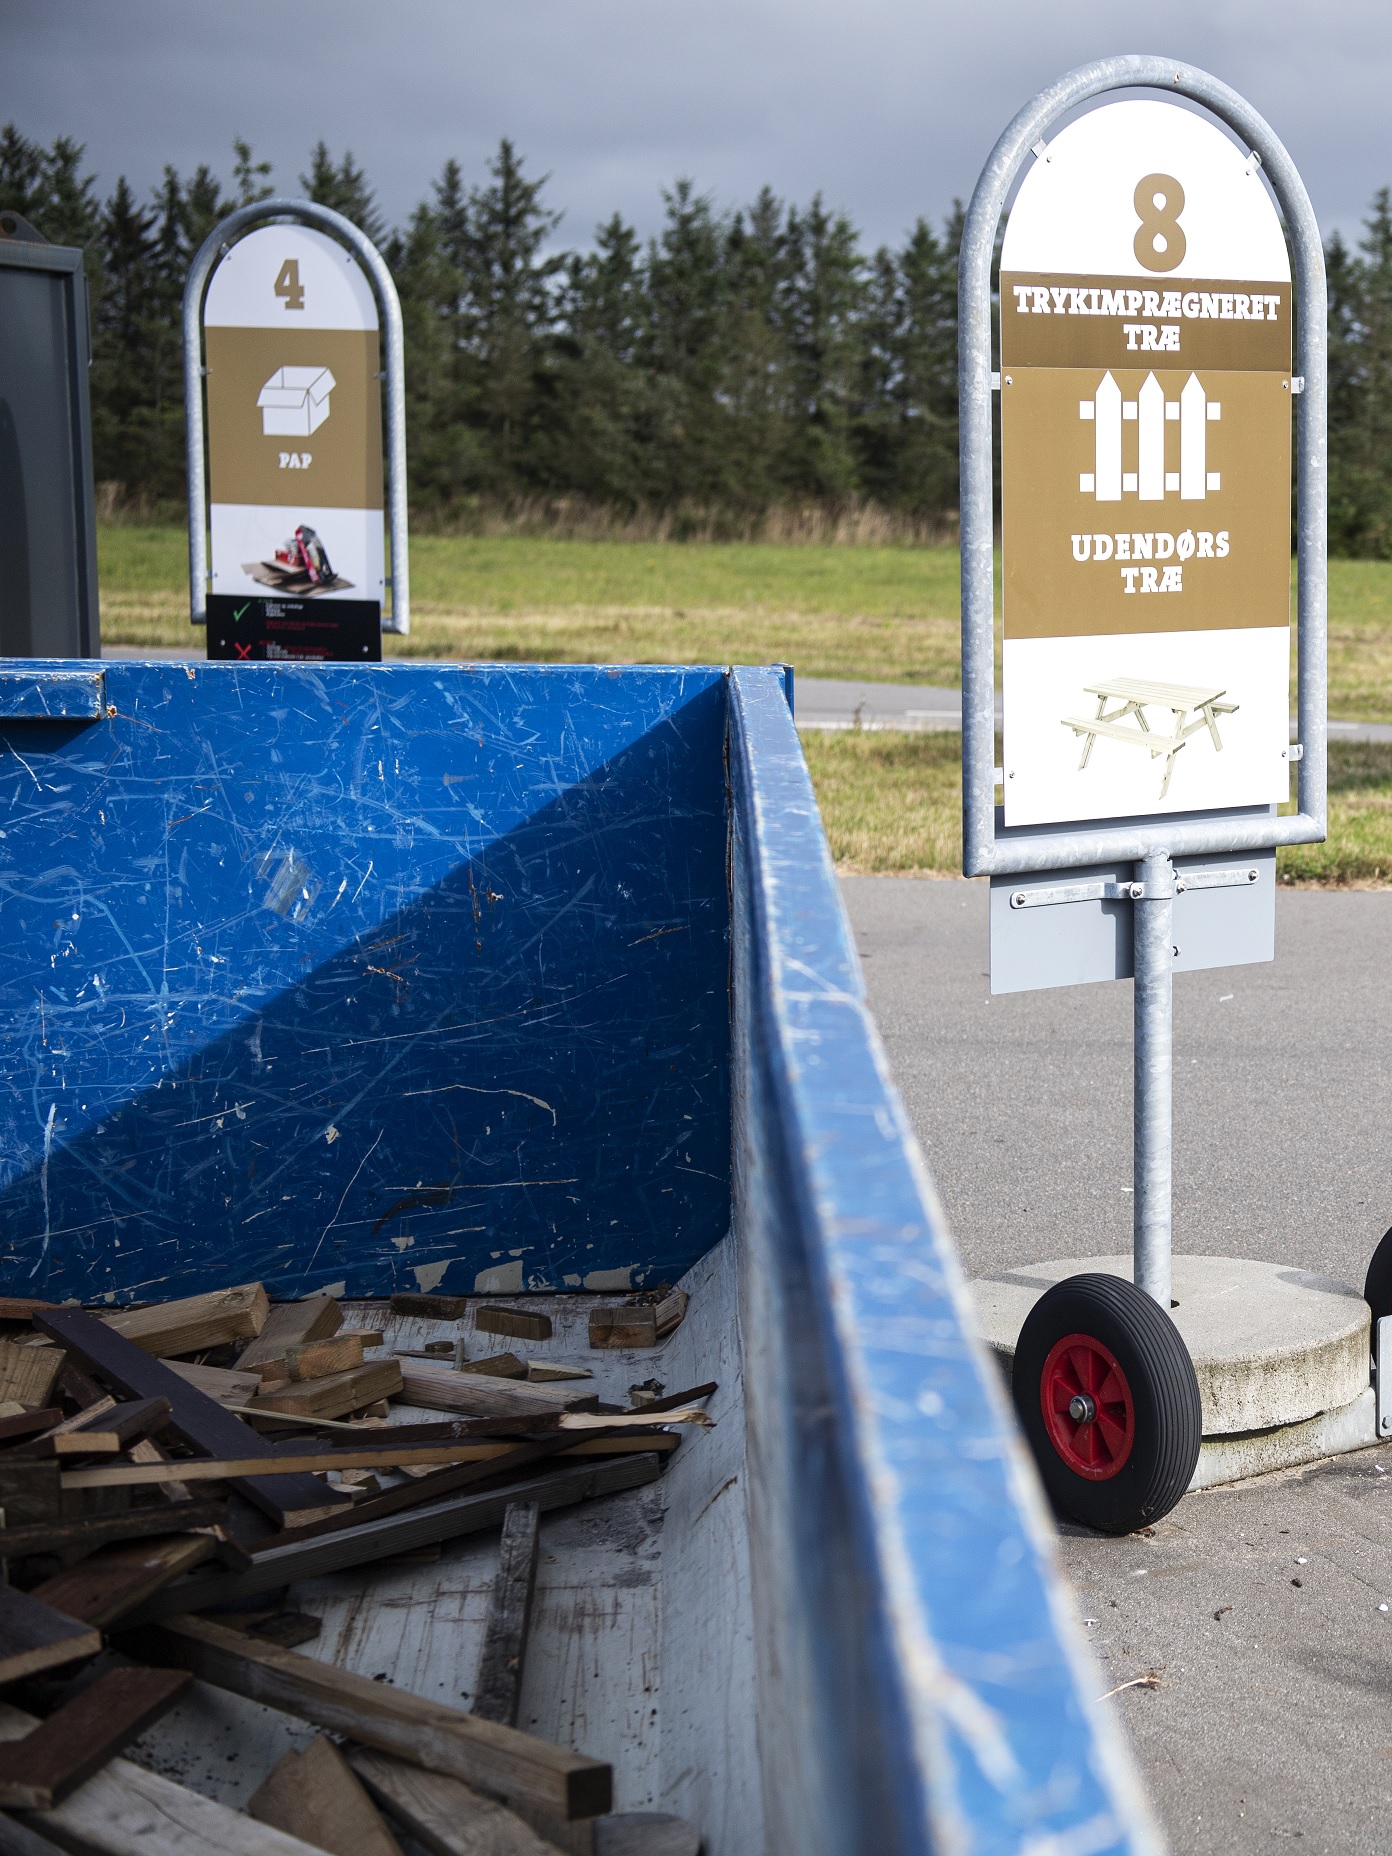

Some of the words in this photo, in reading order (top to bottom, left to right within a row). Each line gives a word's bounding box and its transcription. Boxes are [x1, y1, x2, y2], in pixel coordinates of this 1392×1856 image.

[1133, 173, 1187, 272] 8
[273, 258, 305, 310] 4
[1013, 285, 1281, 321] TRYKIMPRÆGNERET
[1123, 324, 1181, 351] TRÆ
[279, 452, 313, 469] PAP
[1071, 528, 1231, 562] UDENDØRS
[1121, 566, 1183, 594] TRÆ
